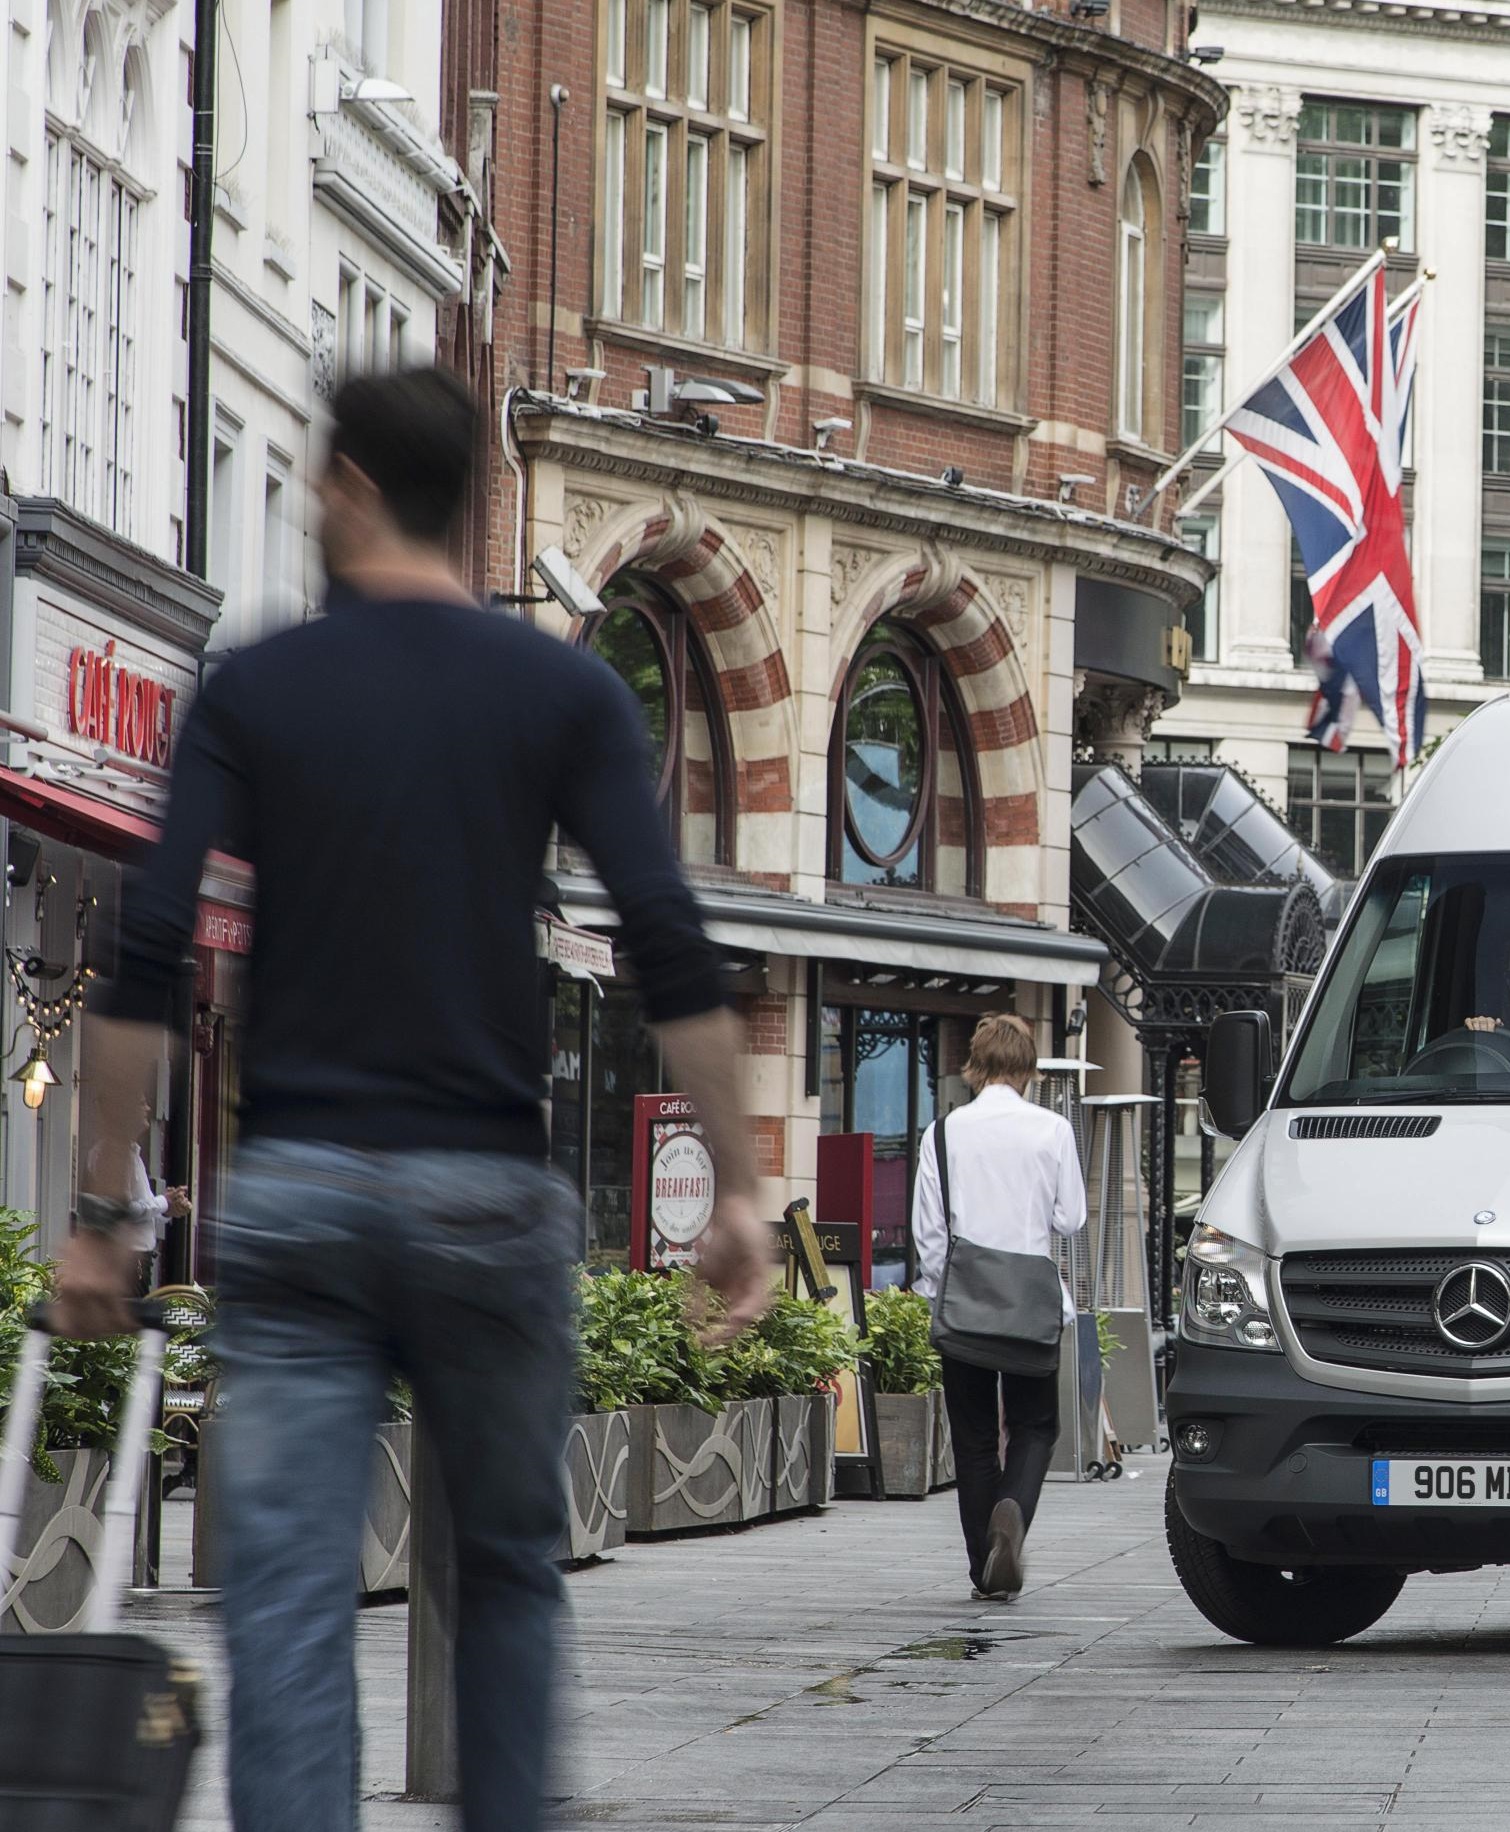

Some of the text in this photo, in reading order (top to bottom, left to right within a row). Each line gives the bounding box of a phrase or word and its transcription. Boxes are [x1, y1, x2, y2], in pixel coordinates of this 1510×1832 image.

[67, 639, 116, 745] CAFÉ
[659, 1099, 680, 1115] CAFÉ
[660, 1147, 680, 1171] Join
[696, 1149, 708, 1171] for
[655, 1176, 710, 1199] BREAKFAST!
[1375, 1487, 1388, 1498] GB
[1414, 1465, 1476, 1500] 906
